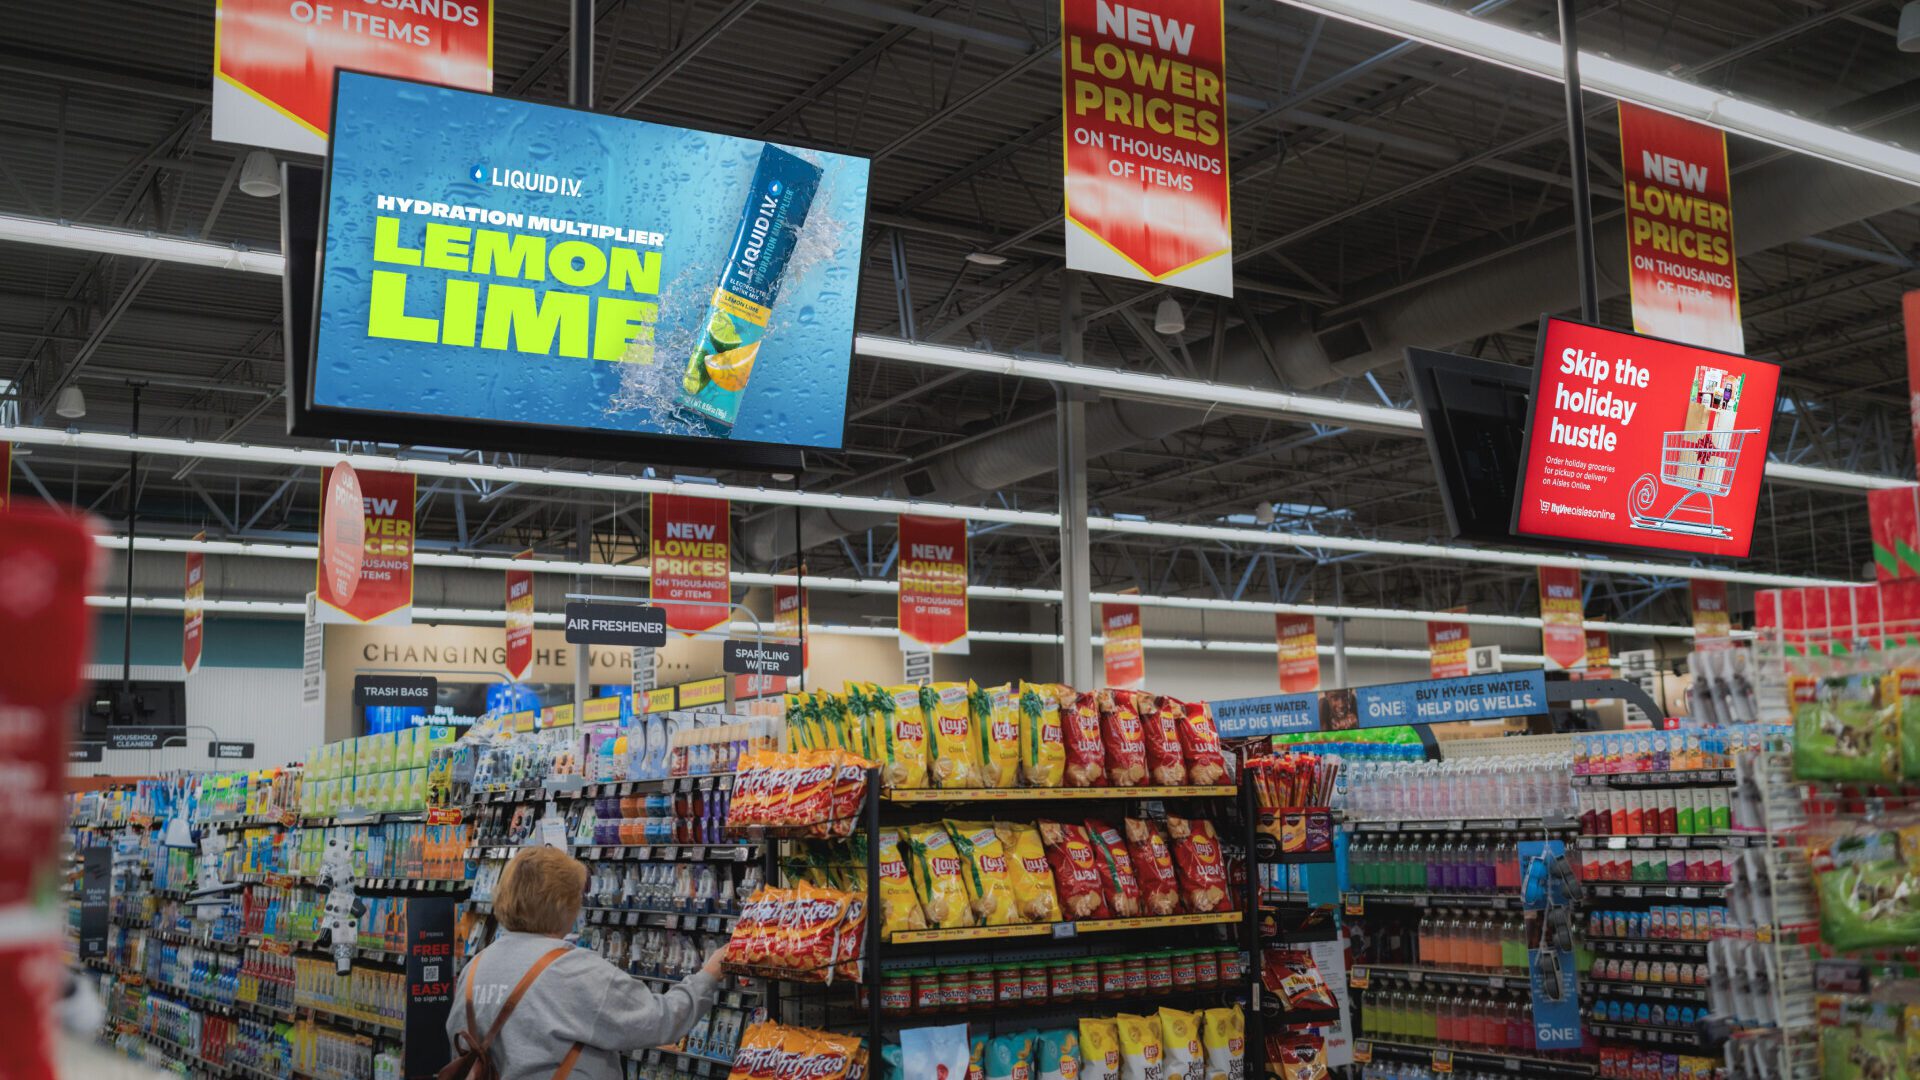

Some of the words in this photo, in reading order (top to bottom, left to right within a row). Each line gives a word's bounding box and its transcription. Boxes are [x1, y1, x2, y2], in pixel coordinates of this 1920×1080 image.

[290, 1, 333, 25] OF
[342, 10, 431, 46] ITEMS
[1096, 0, 1195, 56] NEW
[1070, 34, 1220, 107] LOWER
[1075, 79, 1220, 146] PRICES
[1074, 127, 1104, 148] ON
[1109, 133, 1222, 175] THOUSANDS
[492, 167, 559, 194] LIQUID
[1108, 160, 1135, 178] OF
[1140, 165, 1194, 192] ITEMS
[1642, 150, 1708, 193] NEW
[1628, 181, 1728, 233] LOWER
[377, 195, 523, 228] HYDRATION
[528, 216, 665, 247] MULTIPLIER
[738, 219, 770, 280] LIQUID
[1633, 216, 1729, 266] PRICES
[373, 216, 662, 295] LEMON
[1635, 255, 1655, 272] ON
[1656, 260, 1732, 289] THOUSANDS
[1657, 279, 1674, 297] OF
[1677, 285, 1712, 303] ITEMS
[368, 270, 659, 366] LIME
[1560, 347, 1610, 385] Skip
[1614, 358, 1650, 388] the
[1554, 382, 1637, 426] holiday
[1550, 417, 1618, 452] hustle
[1545, 456, 1565, 465] Order
[1564, 458, 1587, 469] holiday
[1588, 462, 1616, 473] groceries
[1544, 466, 1553, 475] for
[1554, 468, 1575, 479] pickup
[1584, 472, 1608, 483] delivery
[1552, 479, 1571, 488] Aisles
[363, 497, 398, 516] EW
[666, 522, 716, 540] NEW
[365, 537, 409, 556] CES
[654, 539, 727, 559] LOWER
[911, 543, 954, 560] NEW
[655, 558, 727, 577] PRICES
[901, 560, 965, 579] LOWER
[510, 580, 528, 598] NEW
[655, 579, 669, 587] ON
[671, 579, 727, 590] THOUSANDS
[670, 589, 683, 598] OF
[684, 590, 712, 599] ITEMS
[902, 577, 964, 596] PRICES
[1547, 585, 1574, 598] NEW
[915, 596, 964, 607] THOUSANDS
[915, 606, 927, 614] OF
[928, 607, 952, 615] ITEMS
[567, 618, 589, 631] AIR
[592, 619, 663, 634] FRESHENER
[1109, 612, 1134, 628] NEW
[1283, 623, 1308, 636] NEW
[1435, 628, 1462, 641] NEW
[363, 642, 506, 665] CHANGING
[735, 649, 790, 662] SPARKLING
[364, 687, 399, 697] TRASH
[401, 687, 429, 697] BAGS
[1416, 687, 1439, 701] BUY
[1442, 684, 1484, 698] HY-VEE
[1488, 679, 1534, 694] WATER.
[434, 705, 454, 718] Buy
[1219, 707, 1237, 718] BUY
[1240, 703, 1272, 715] HY-VEE
[1274, 700, 1311, 713] WATER.
[1369, 701, 1402, 717] ONE
[1417, 701, 1451, 716] HELP
[1455, 699, 1480, 713] DIG
[1482, 694, 1537, 711] WELLS.
[447, 715, 477, 726] Water
[1220, 718, 1247, 731] HELP
[1248, 717, 1268, 729] DIG
[1270, 713, 1313, 728] WELLS.
[412, 944, 450, 957] FREE
[412, 983, 450, 996] EASY
[423, 995, 437, 1003] sign
[1538, 1028, 1574, 1042] ONE
